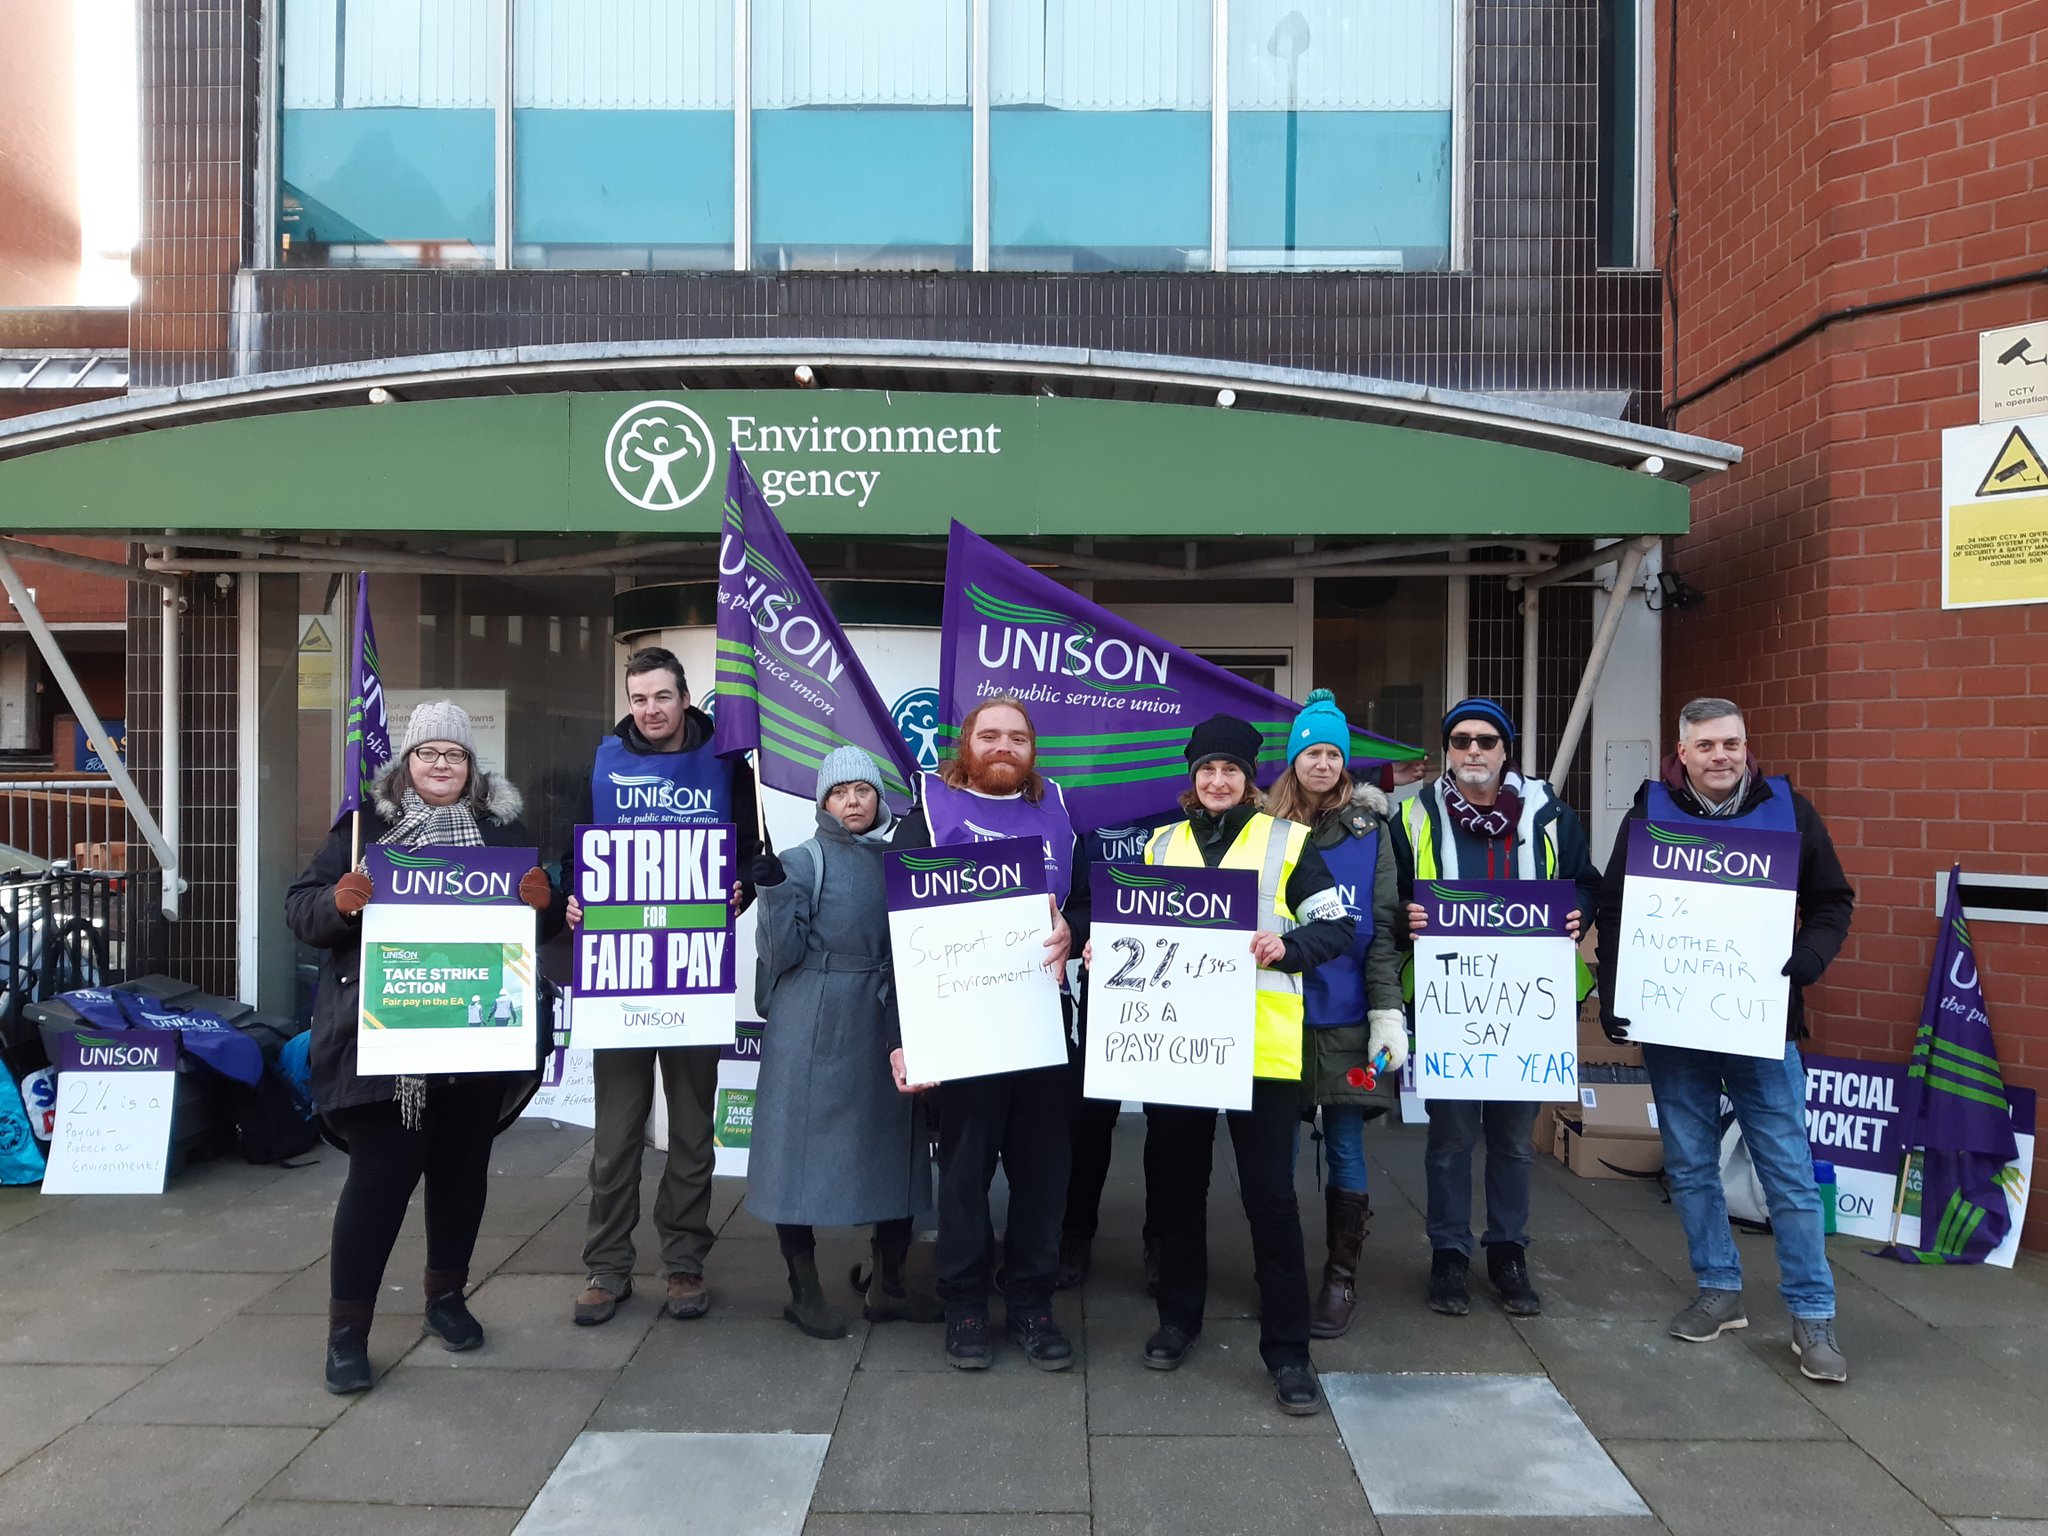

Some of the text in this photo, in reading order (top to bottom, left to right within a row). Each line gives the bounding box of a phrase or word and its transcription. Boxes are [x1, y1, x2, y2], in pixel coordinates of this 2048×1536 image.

[2005, 395, 2048, 408] operation
[2009, 386, 2035, 397] CCTV
[726, 416, 1001, 454] Environment
[762, 468, 881, 507] gency
[1955, 541, 1994, 551] RECORDING
[1996, 539, 2024, 547] SYSTEM
[1964, 548, 1996, 556] SECURITY
[1977, 552, 2025, 562] ENVIRONMENT
[716, 585, 731, 604] he
[719, 534, 845, 683] UISON
[978, 624, 1170, 685] UNISON
[790, 678, 836, 717] union
[976, 679, 1004, 698] the
[1064, 691, 1125, 710] service
[1130, 695, 1182, 715] union
[616, 786, 712, 809] UNISON
[617, 812, 719, 825] the public service union
[1102, 835, 1149, 861] UNIS
[582, 829, 727, 902] STRIKE
[1652, 845, 1772, 879] UNISON
[391, 869, 511, 896] UNISON
[910, 862, 1022, 899] UNISON
[1116, 888, 1232, 919] UNISON
[1306, 899, 1340, 920] OFFICIAL
[1437, 903, 1549, 928] UNISON
[643, 906, 667, 928] FOR
[383, 951, 418, 959] UNISON
[909, 925, 1041, 969] Support our
[1631, 927, 1743, 958] ANOTHER
[382, 967, 489, 980] TAKE STRIKE
[581, 931, 726, 991] FAIR PAY
[1103, 936, 1181, 992] 2%
[1435, 952, 1499, 978] THEY
[1663, 957, 1757, 983] UNFAIR
[382, 982, 446, 994] ACTION
[1420, 977, 1556, 1020] ALWAYS
[1641, 979, 1777, 1022] PAY CUT
[382, 997, 464, 1008] Fair pay in the EA
[1119, 1000, 1177, 1024] IS A
[1940, 995, 1966, 1014] the
[150, 1016, 220, 1029] UNISON
[624, 1012, 685, 1027] UNISON
[1462, 1022, 1511, 1047] SAY
[80, 1046, 158, 1066] UNISON
[1425, 1052, 1499, 1079] NEXT
[1516, 1051, 1576, 1086] YEAR
[121, 1095, 137, 1110] is
[149, 1098, 160, 1109] a
[1805, 1067, 1900, 1114] FFICIAL
[727, 1106, 753, 1117] TAKE
[114, 1143, 132, 1152] our
